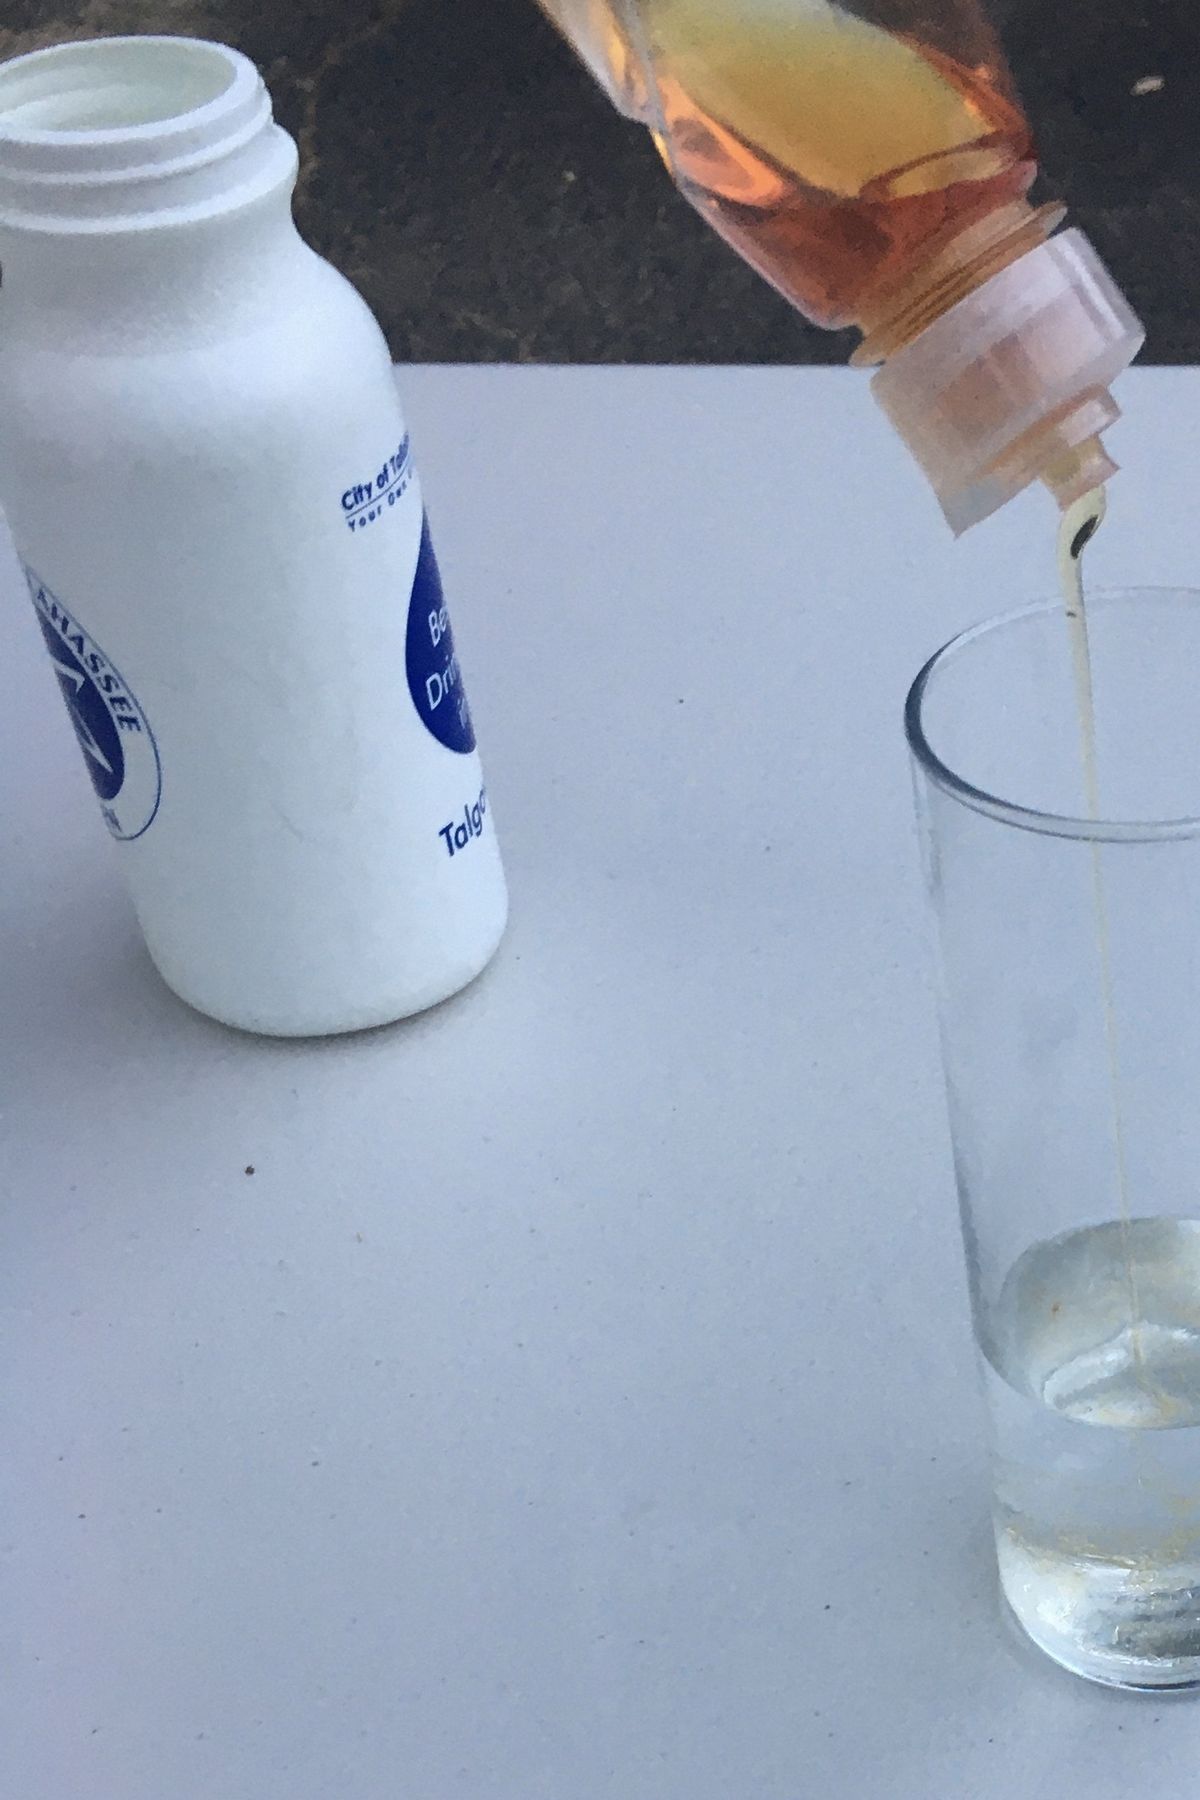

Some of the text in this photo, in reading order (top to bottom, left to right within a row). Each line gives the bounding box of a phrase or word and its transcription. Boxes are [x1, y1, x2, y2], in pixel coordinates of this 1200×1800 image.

[341, 481, 372, 511] City
[376, 463, 389, 489] of
[348, 505, 382, 532] Your
